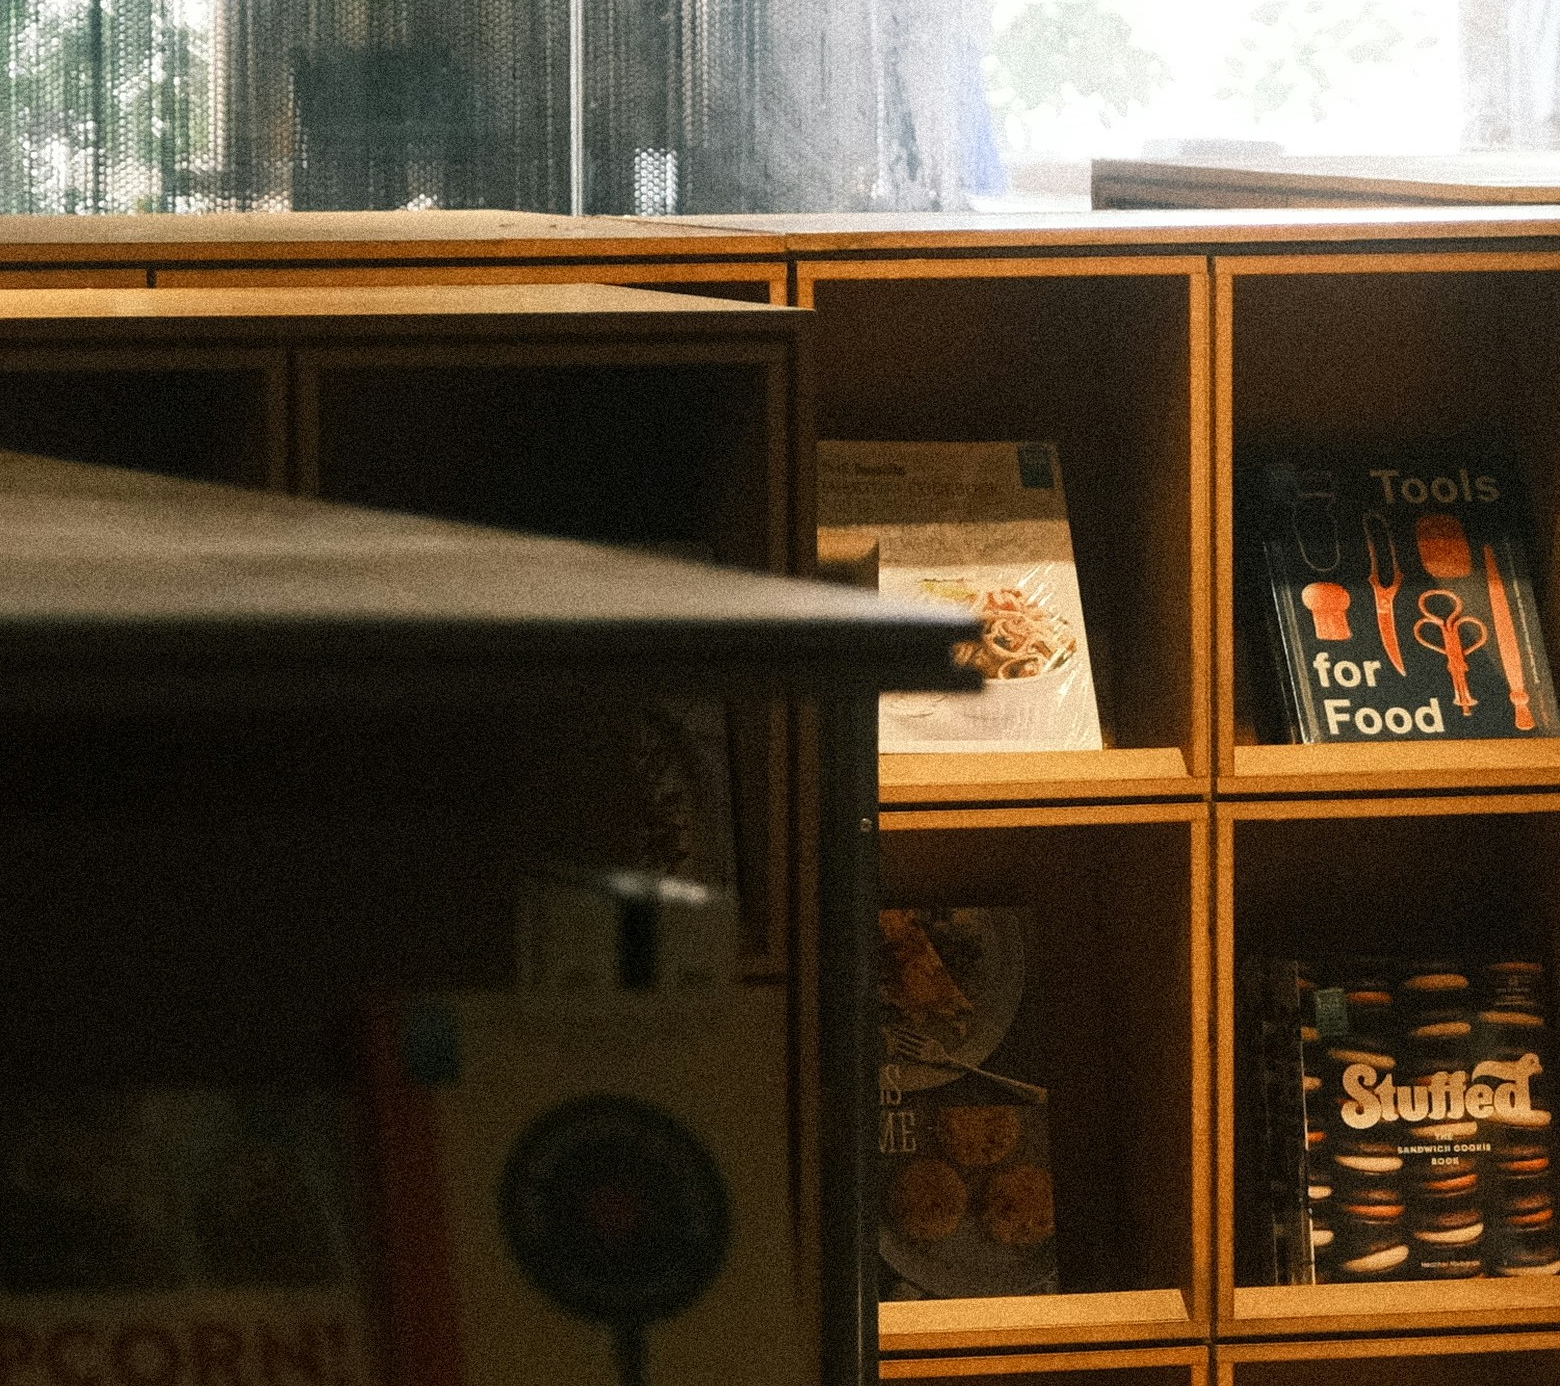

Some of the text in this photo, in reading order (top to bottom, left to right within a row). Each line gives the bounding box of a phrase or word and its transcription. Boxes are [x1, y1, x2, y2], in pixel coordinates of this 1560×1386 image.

[1370, 468, 1501, 505] Tools
[1313, 651, 1382, 688] for
[1323, 697, 1446, 736] Food
[1341, 1052, 1544, 1130] Stuffed
[1397, 1145, 1451, 1154] SANDWICH
[1430, 1156, 1460, 1166] BOOK
